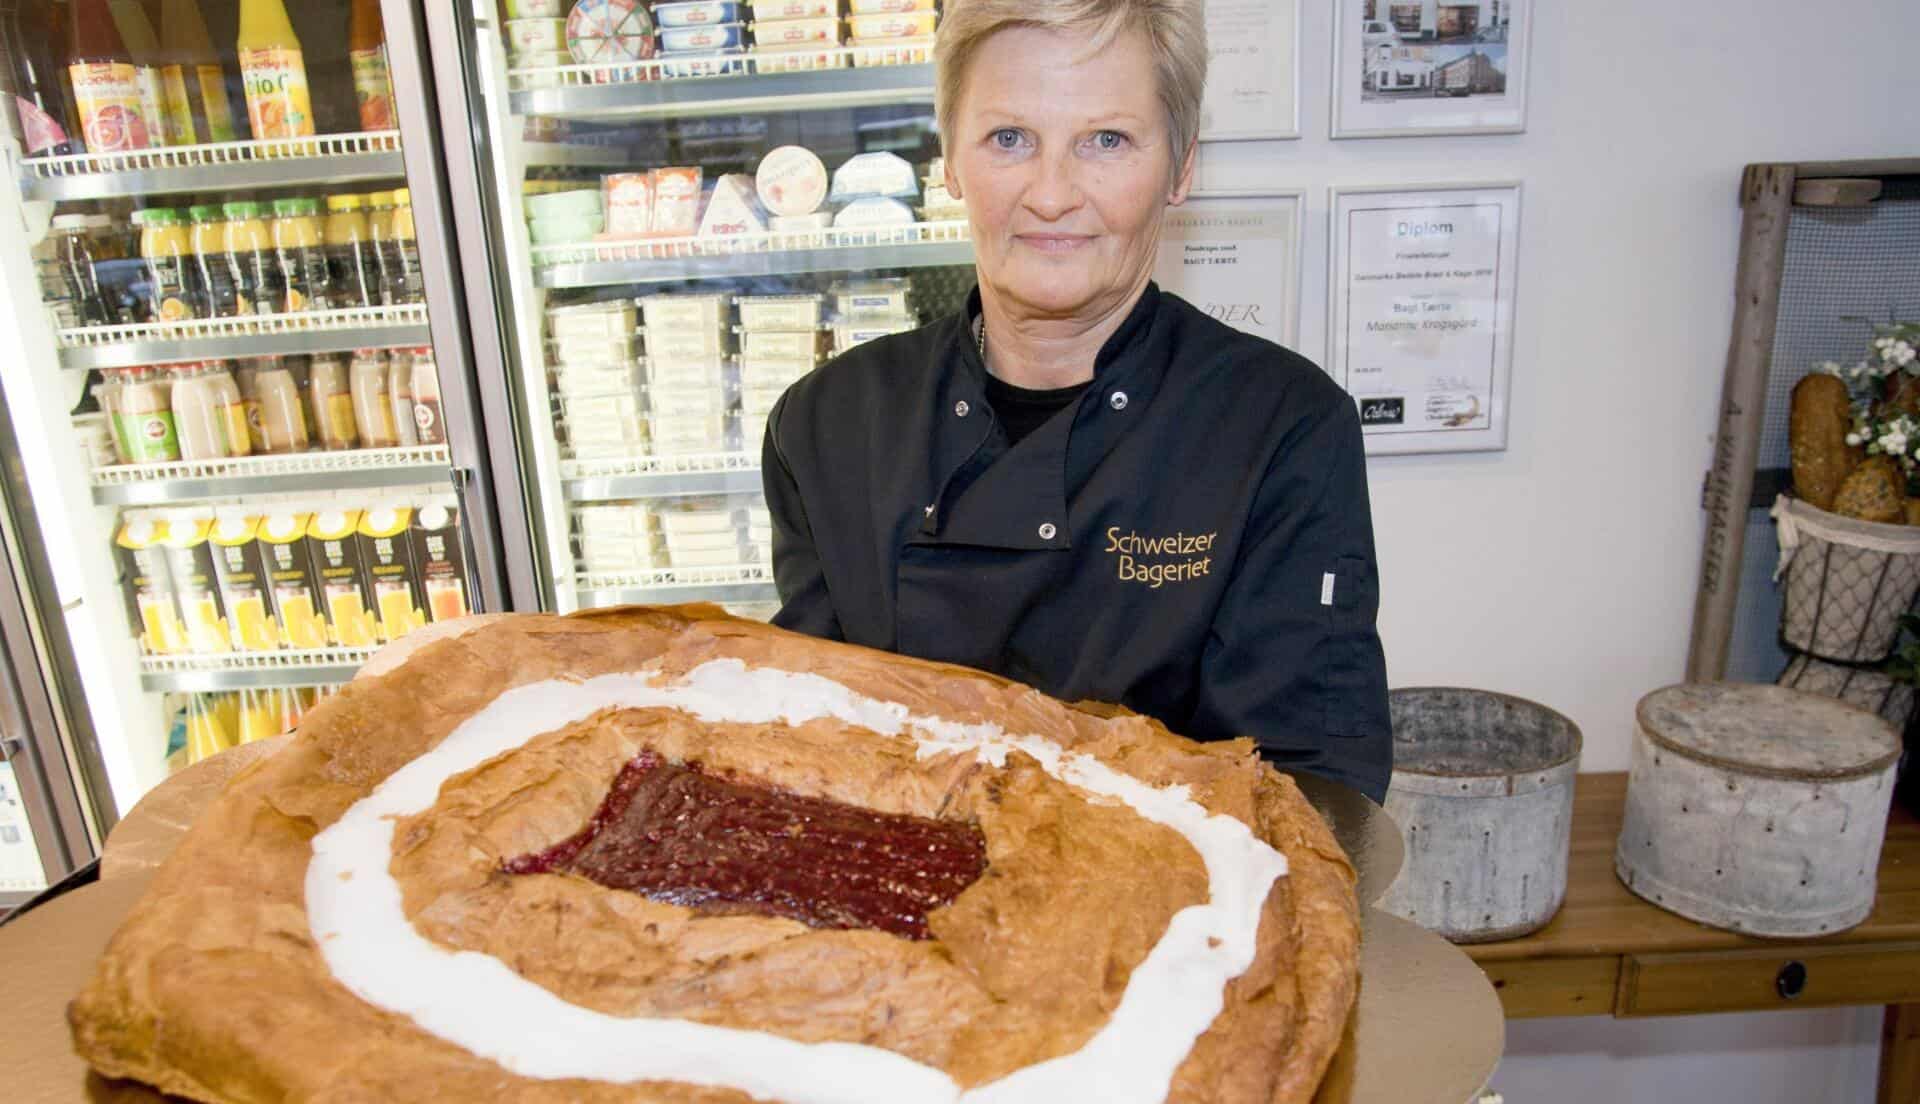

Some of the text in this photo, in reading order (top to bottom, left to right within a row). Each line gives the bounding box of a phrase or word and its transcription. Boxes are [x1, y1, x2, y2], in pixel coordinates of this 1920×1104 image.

[1397, 221, 1454, 237] Diplom
[1104, 526, 1217, 555] Schweizer
[1119, 555, 1211, 588] Bageriet
